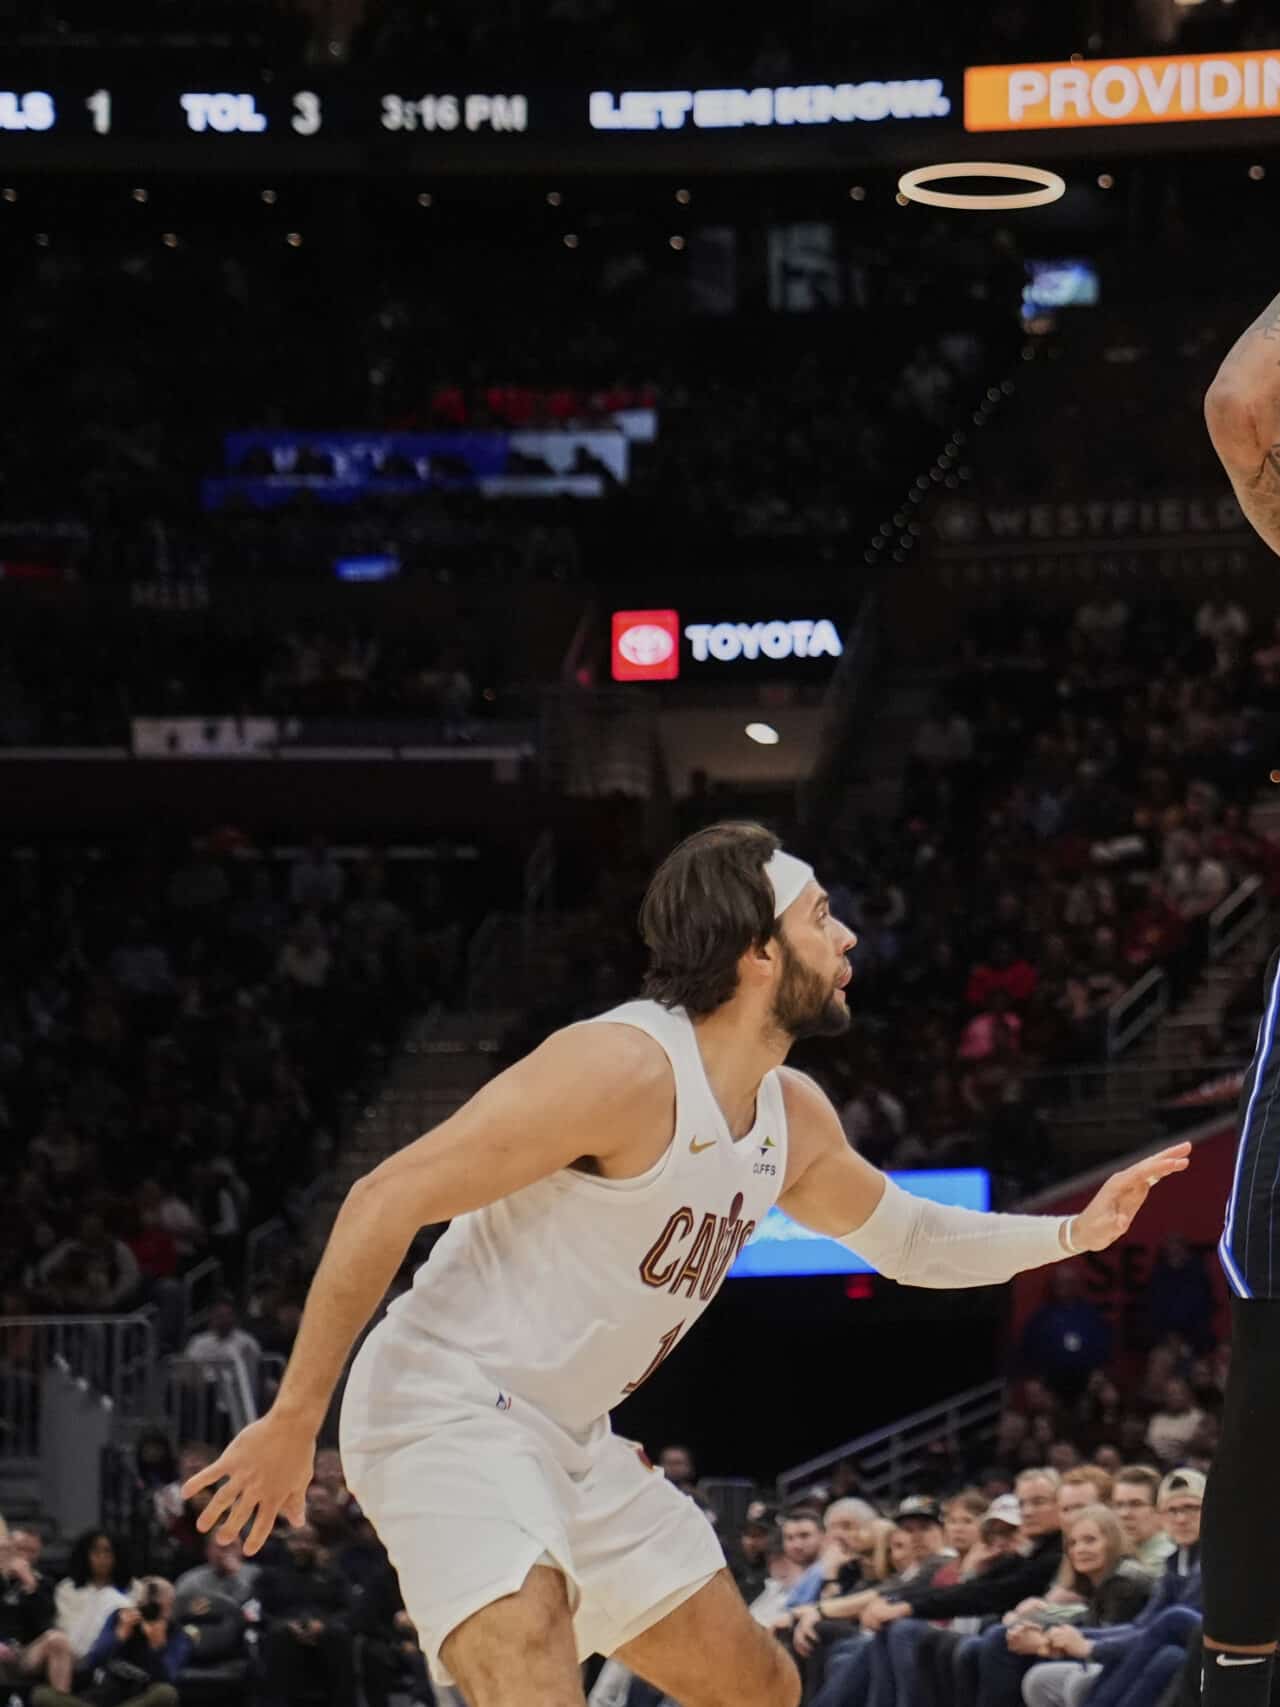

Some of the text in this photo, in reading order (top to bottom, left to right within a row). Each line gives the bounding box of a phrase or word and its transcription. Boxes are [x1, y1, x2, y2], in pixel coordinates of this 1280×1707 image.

[87, 90, 110, 134] 1
[180, 92, 267, 132] TOL
[292, 91, 321, 135] 3
[381, 94, 459, 131] 3:16
[464, 94, 527, 131] PM
[684, 618, 843, 662] TOYOTA
